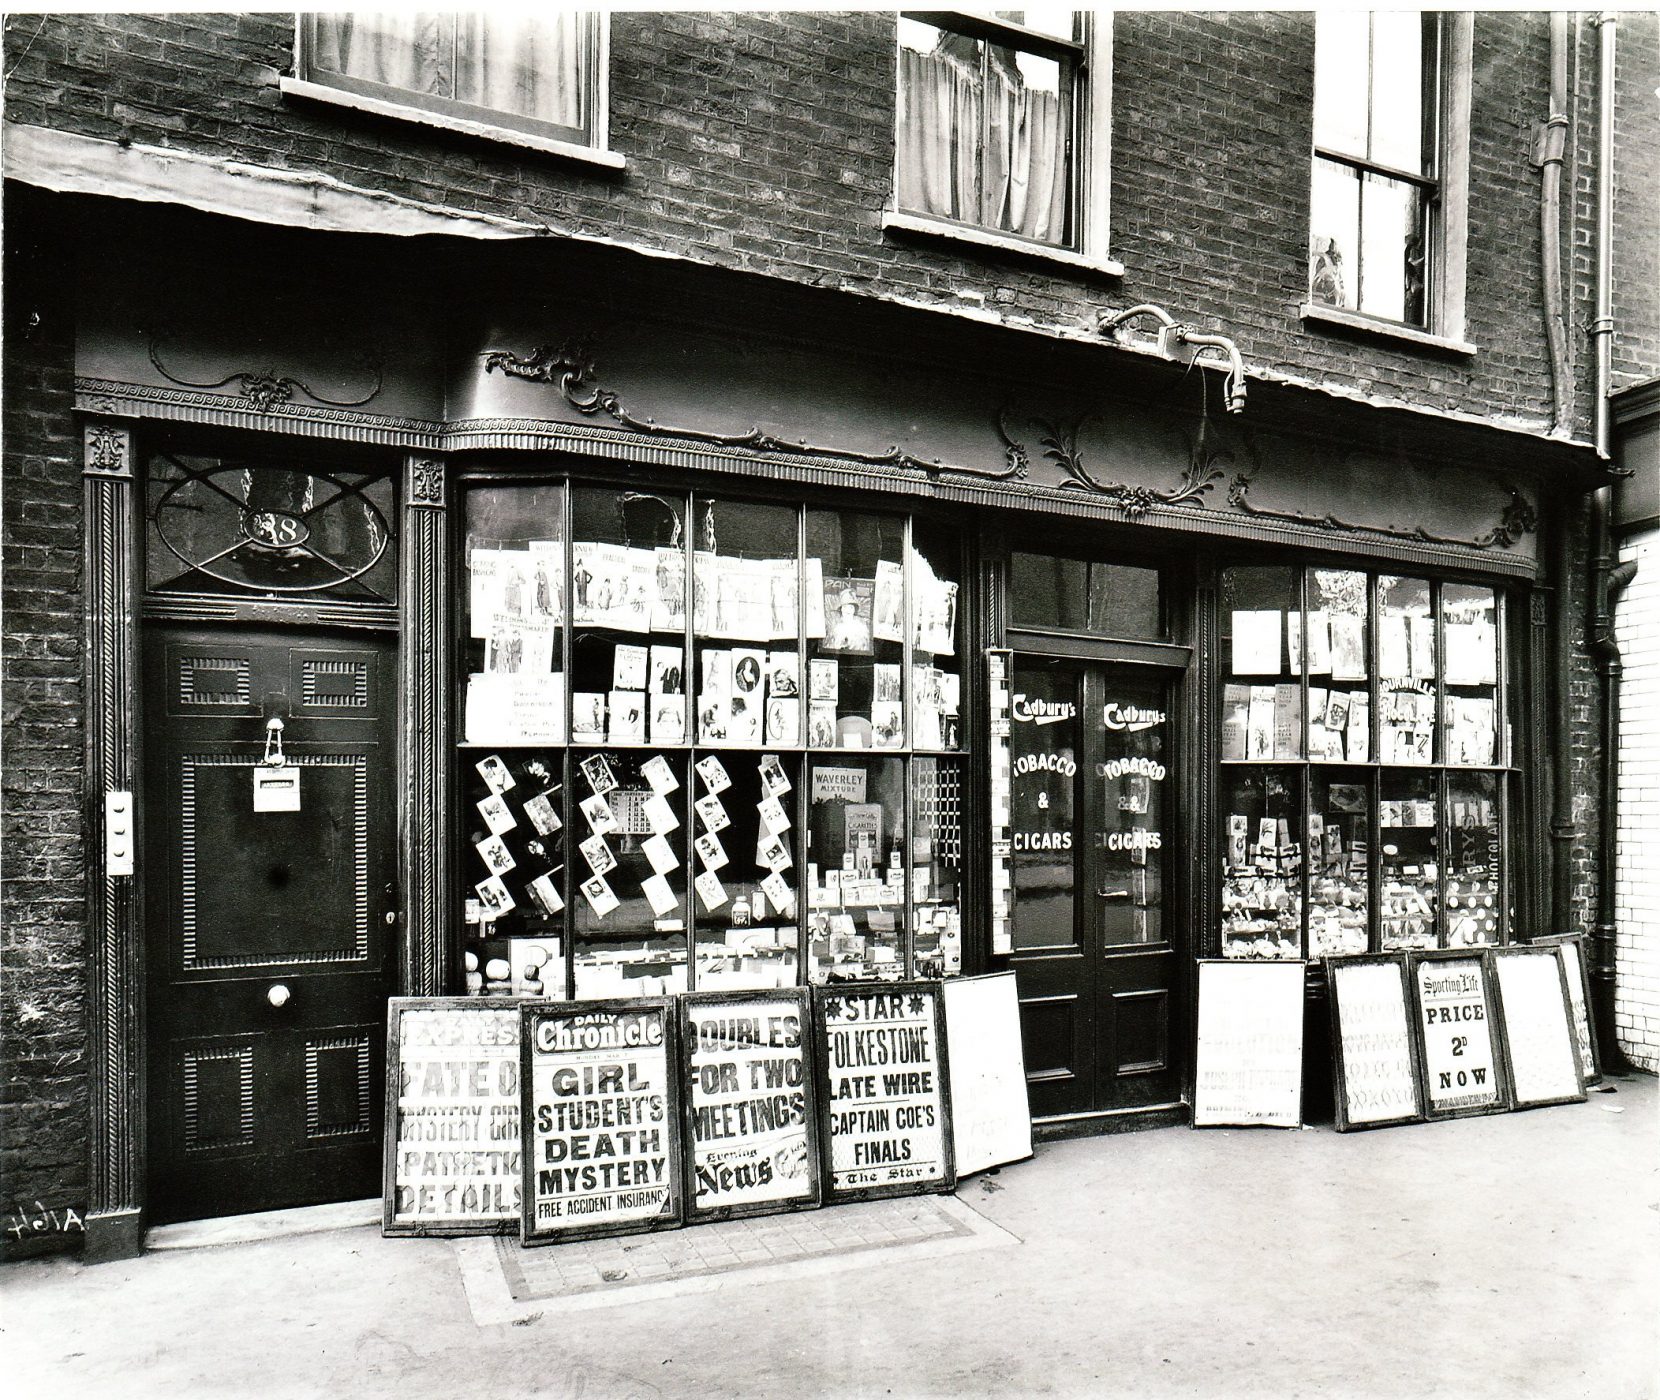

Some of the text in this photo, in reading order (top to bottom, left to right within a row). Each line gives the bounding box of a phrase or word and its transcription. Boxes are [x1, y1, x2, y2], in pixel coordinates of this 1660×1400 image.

[1012, 694, 1076, 722] Cadbury's
[1013, 753, 1076, 777] TOBACCO
[1104, 757, 1166, 780] TOBACCO
[815, 774, 863, 785] WAVERLEY
[820, 785, 856, 793] MIXTURE
[1038, 792, 1048, 809] &
[1014, 832, 1072, 850] CIGARS
[1108, 832, 1161, 850] CIGARS
[1424, 976, 1461, 997] Sporting
[574, 1014, 617, 1027] DAILY
[845, 993, 905, 1021] STAR
[1426, 1004, 1484, 1025] PRICE
[409, 1021, 520, 1047] EXPRES
[536, 1016, 662, 1051] Chronicle
[688, 1016, 801, 1055] DOUBLES
[498, 1061, 521, 1096] O
[551, 1063, 650, 1097] GIRL
[745, 1058, 802, 1089] TWO
[883, 1071, 933, 1096] WIRE
[1439, 1067, 1486, 1089] NOW
[490, 1105, 520, 1140] GIR
[537, 1095, 664, 1133] STUDENT'S
[692, 1092, 805, 1142] MEETINGS
[830, 1104, 935, 1136] CAPTAIN COE'S
[545, 1128, 660, 1163] DEATH
[706, 1149, 758, 1162] Evening
[854, 1138, 911, 1165] FINALS
[539, 1157, 666, 1195] MYSTERY
[695, 1156, 774, 1196] News
[846, 1168, 922, 1184] The Star
[539, 1189, 664, 1219] FREE ACCIDENT INSURANC
